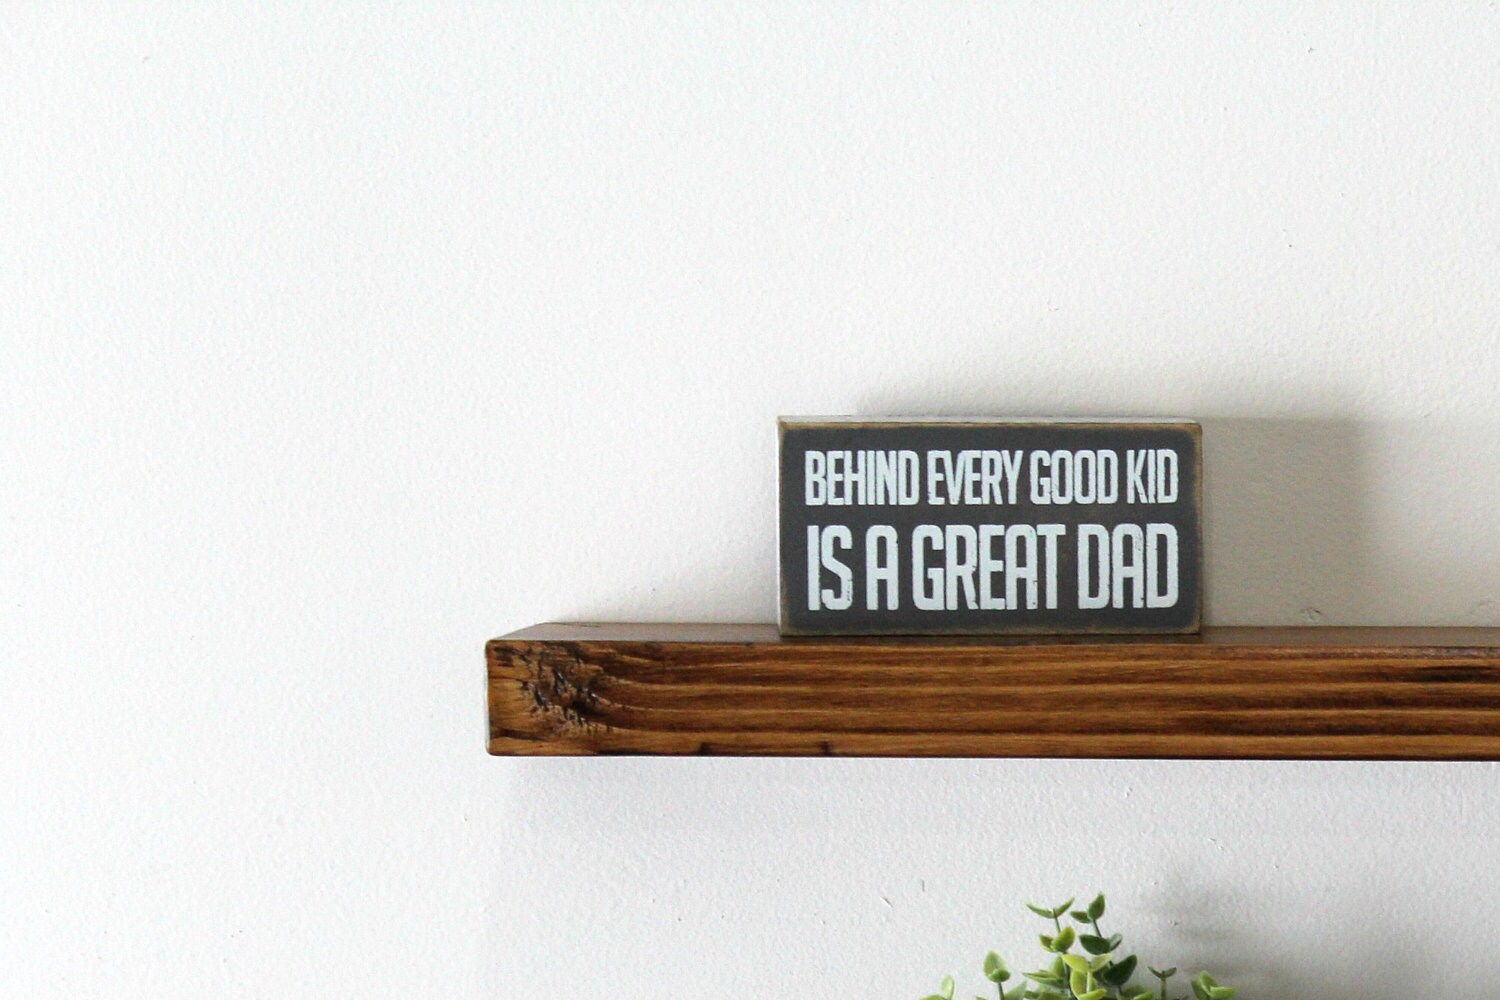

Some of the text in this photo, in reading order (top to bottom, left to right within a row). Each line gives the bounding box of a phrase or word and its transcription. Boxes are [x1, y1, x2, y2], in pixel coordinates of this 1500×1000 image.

[804, 448, 1179, 506] BEHIND EVERY GOOD KID
[807, 522, 1179, 611] IS A GREAT DAD
